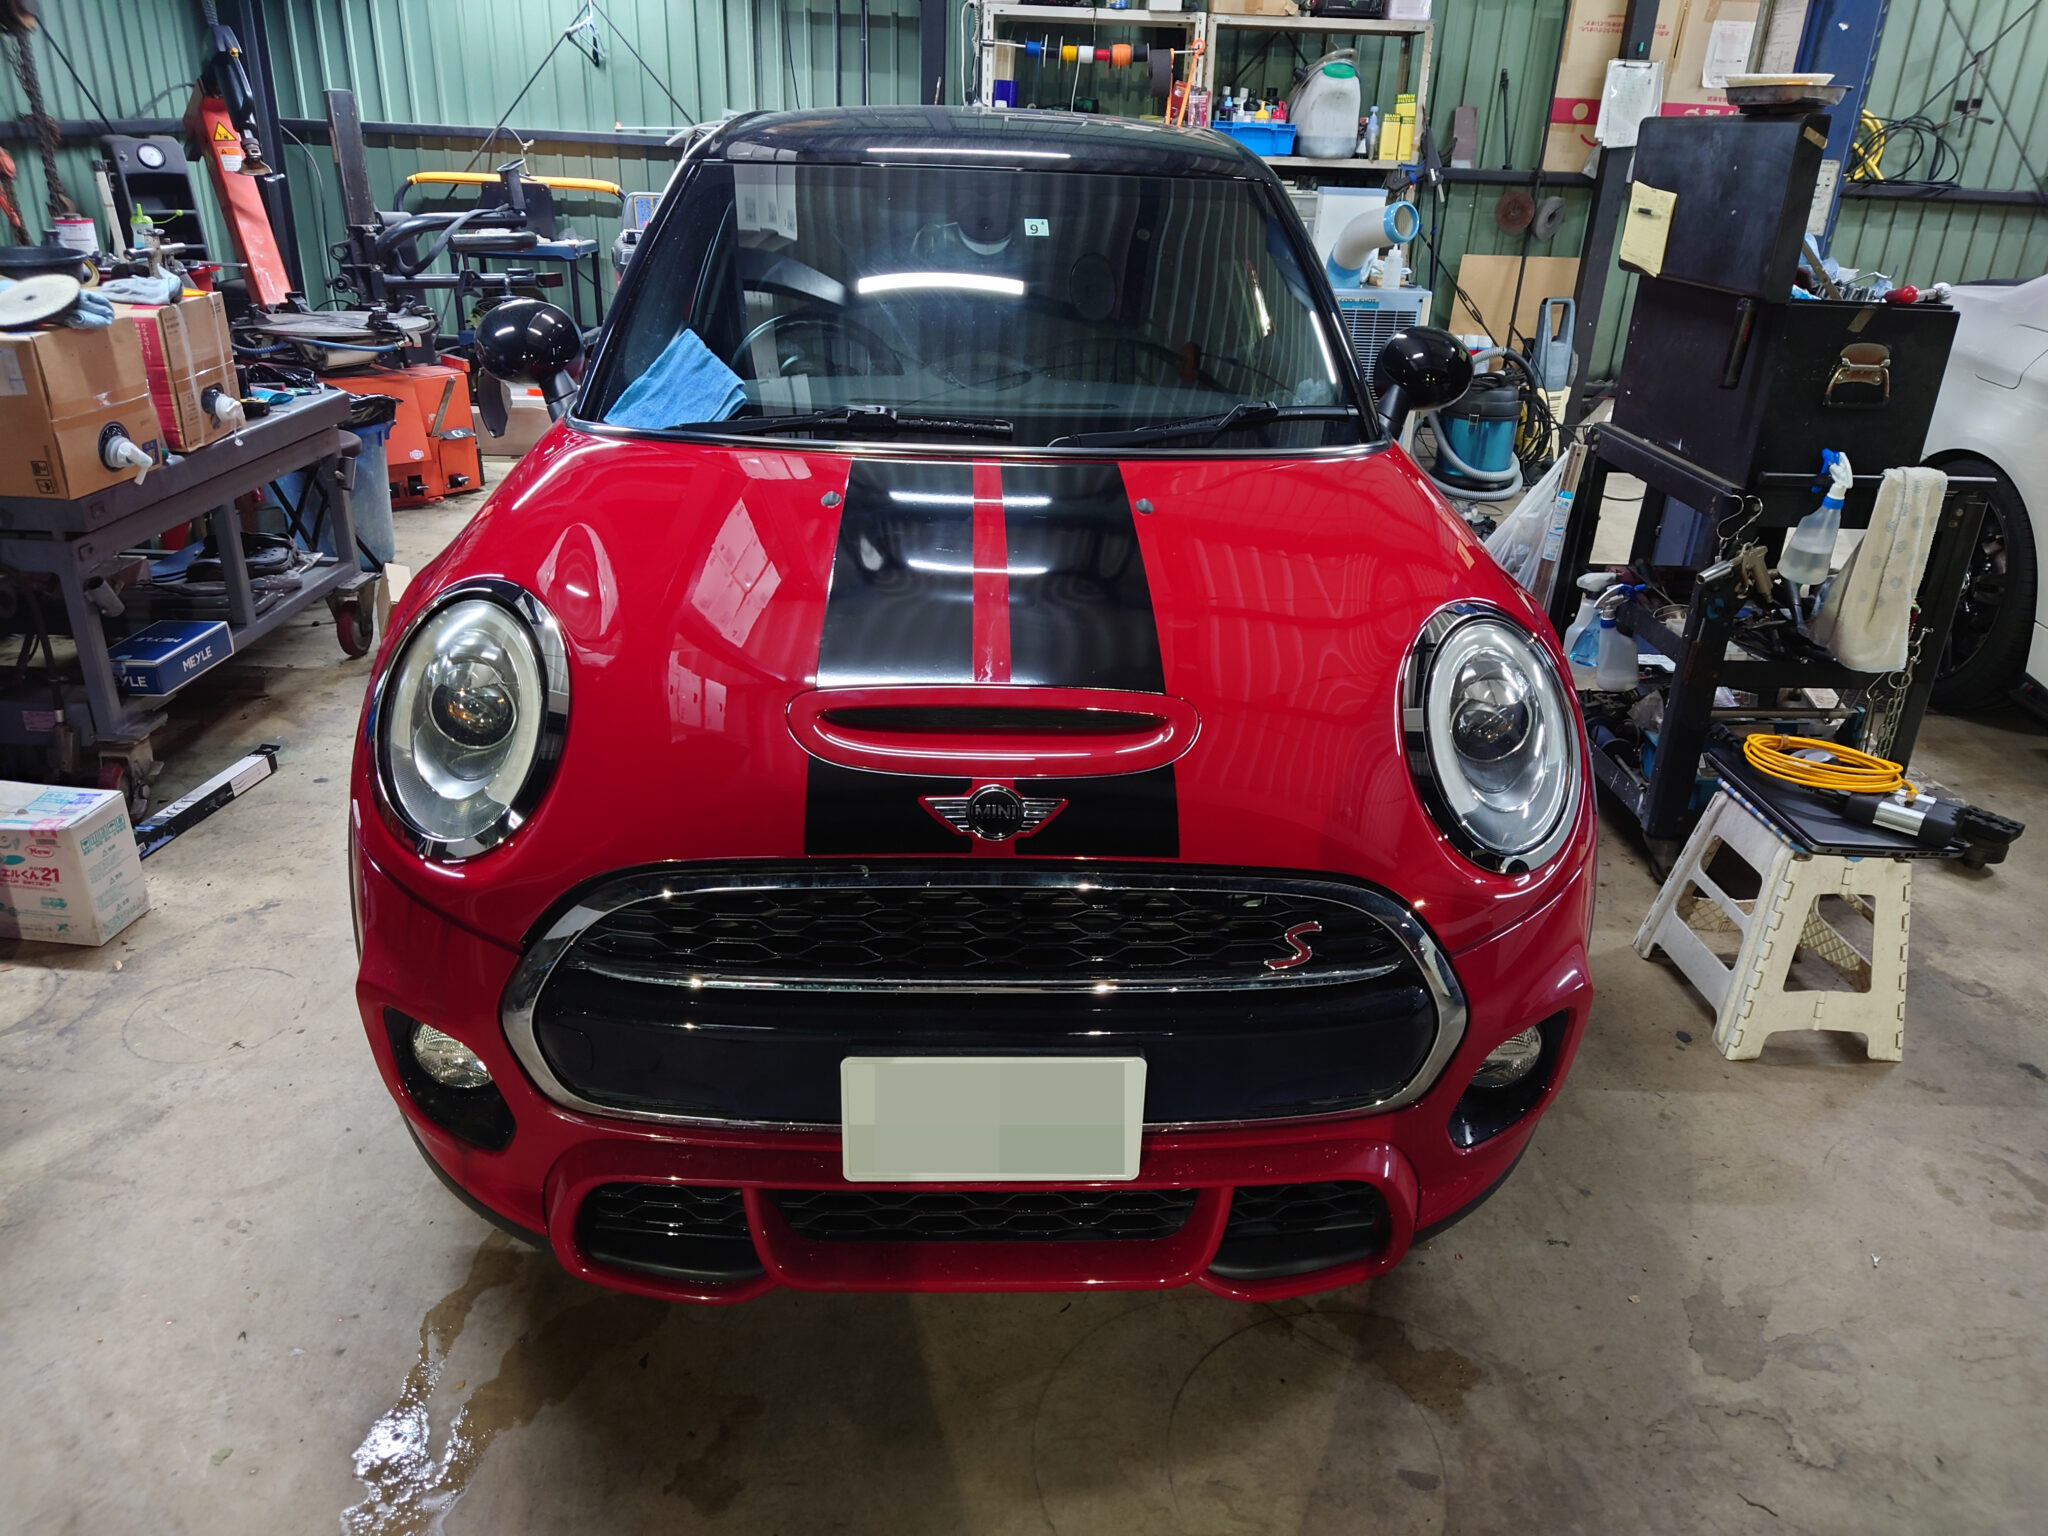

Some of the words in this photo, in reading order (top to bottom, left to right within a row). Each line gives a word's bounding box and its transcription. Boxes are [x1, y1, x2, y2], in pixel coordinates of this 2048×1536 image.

[1030, 224, 1038, 234] 9
[182, 646, 213, 672] MEYLE
[975, 804, 1017, 819] MINI
[29, 847, 51, 856] New
[1263, 920, 1323, 971] S
